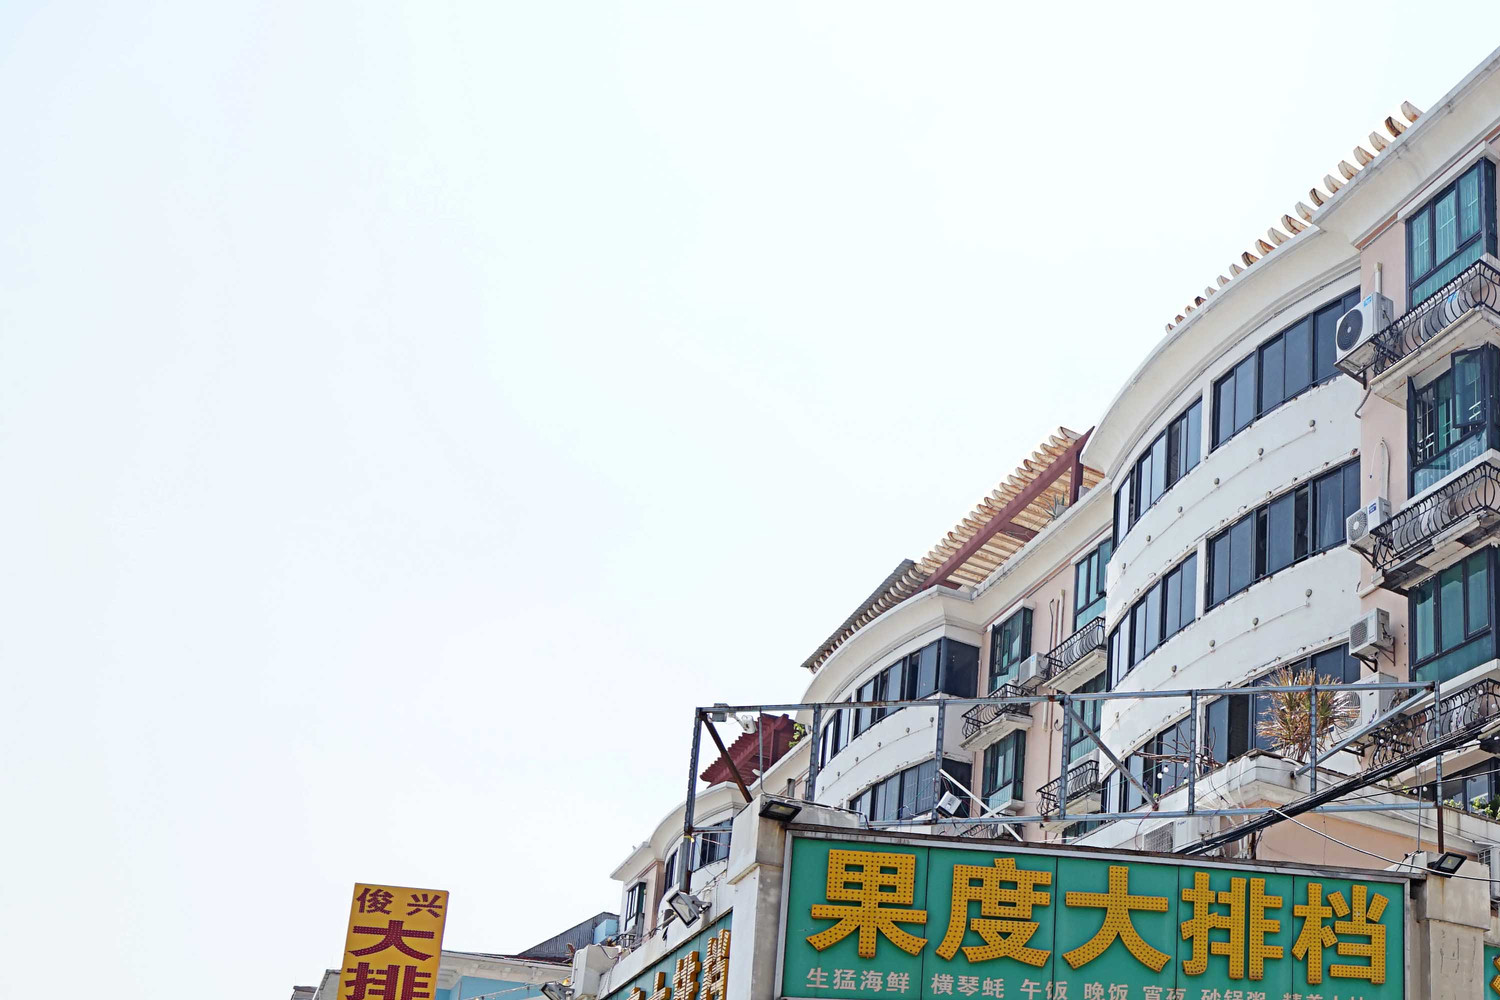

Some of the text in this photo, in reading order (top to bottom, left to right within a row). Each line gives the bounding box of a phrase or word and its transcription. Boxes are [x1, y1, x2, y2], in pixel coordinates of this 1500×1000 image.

[356, 887, 443, 918] 俊兴
[806, 849, 1389, 985] 果度大排档
[806, 967, 910, 993] 生猛海鲜
[930, 973, 1005, 998] 横琴蚝
[1020, 978, 1068, 1000] 午饭
